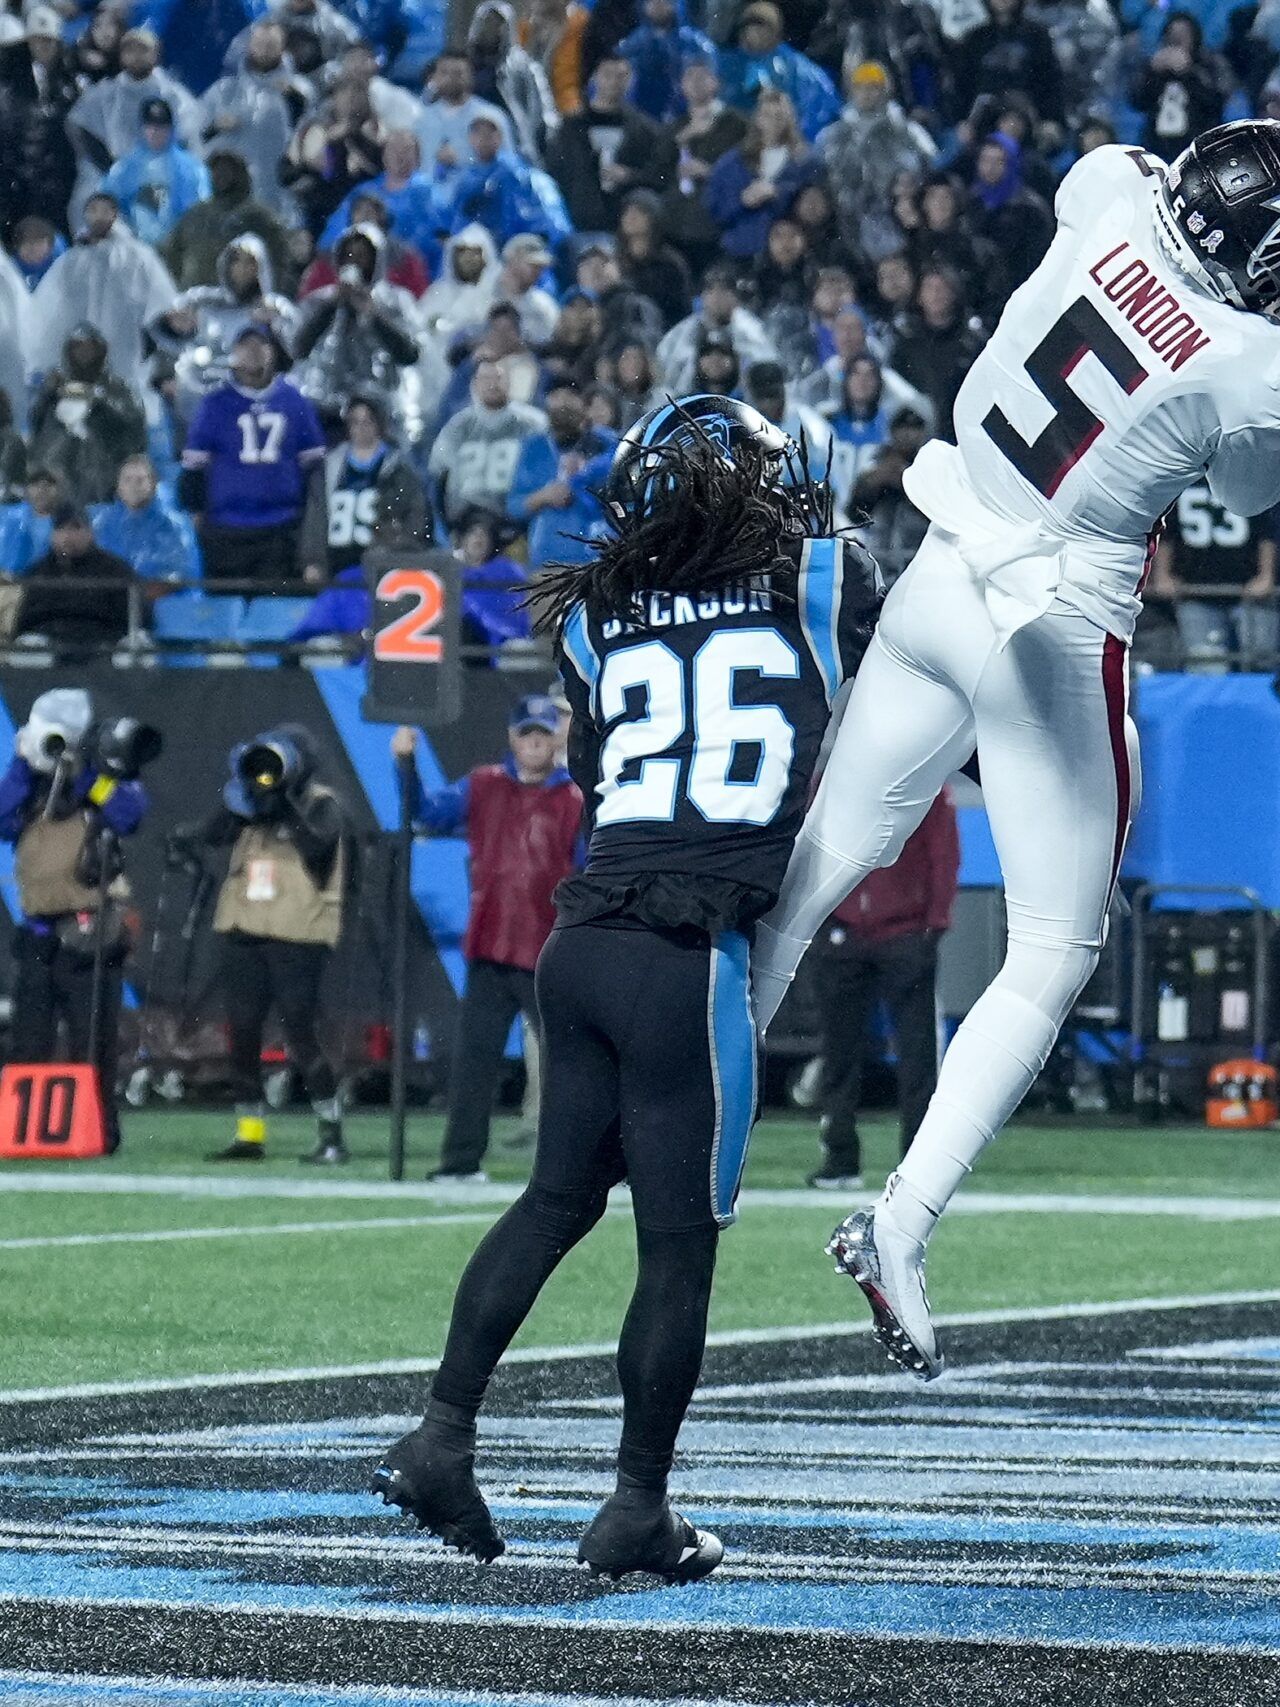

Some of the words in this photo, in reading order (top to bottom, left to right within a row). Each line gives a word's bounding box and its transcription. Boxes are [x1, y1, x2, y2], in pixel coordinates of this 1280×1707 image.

[1089, 242, 1211, 373] LONDON
[237, 412, 287, 464] 17
[981, 295, 1149, 500] 5
[374, 568, 445, 663] 2
[602, 575, 773, 640] JCKSON
[594, 627, 800, 828] 26
[12, 1076, 76, 1145] 10
